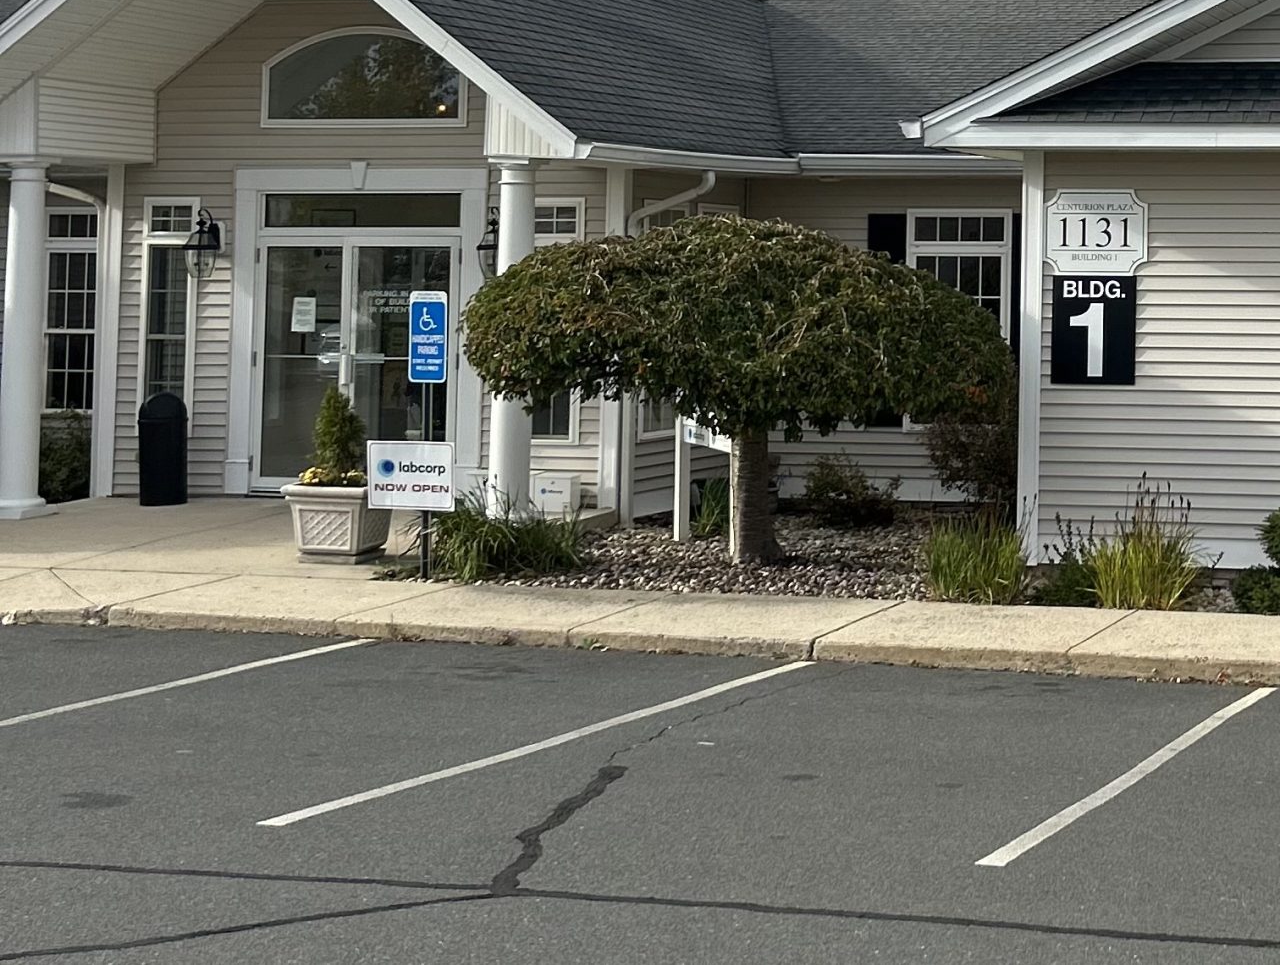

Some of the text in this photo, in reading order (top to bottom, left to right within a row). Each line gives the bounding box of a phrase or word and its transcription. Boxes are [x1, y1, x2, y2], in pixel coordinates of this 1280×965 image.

[1057, 203, 1134, 211] CENTURION PLAZA
[1059, 217, 1131, 248] 1131
[1063, 280, 1126, 299] BLDG.
[1069, 302, 1105, 377] 1
[399, 461, 446, 476] labcorp
[374, 483, 450, 493] NOW OPEN
